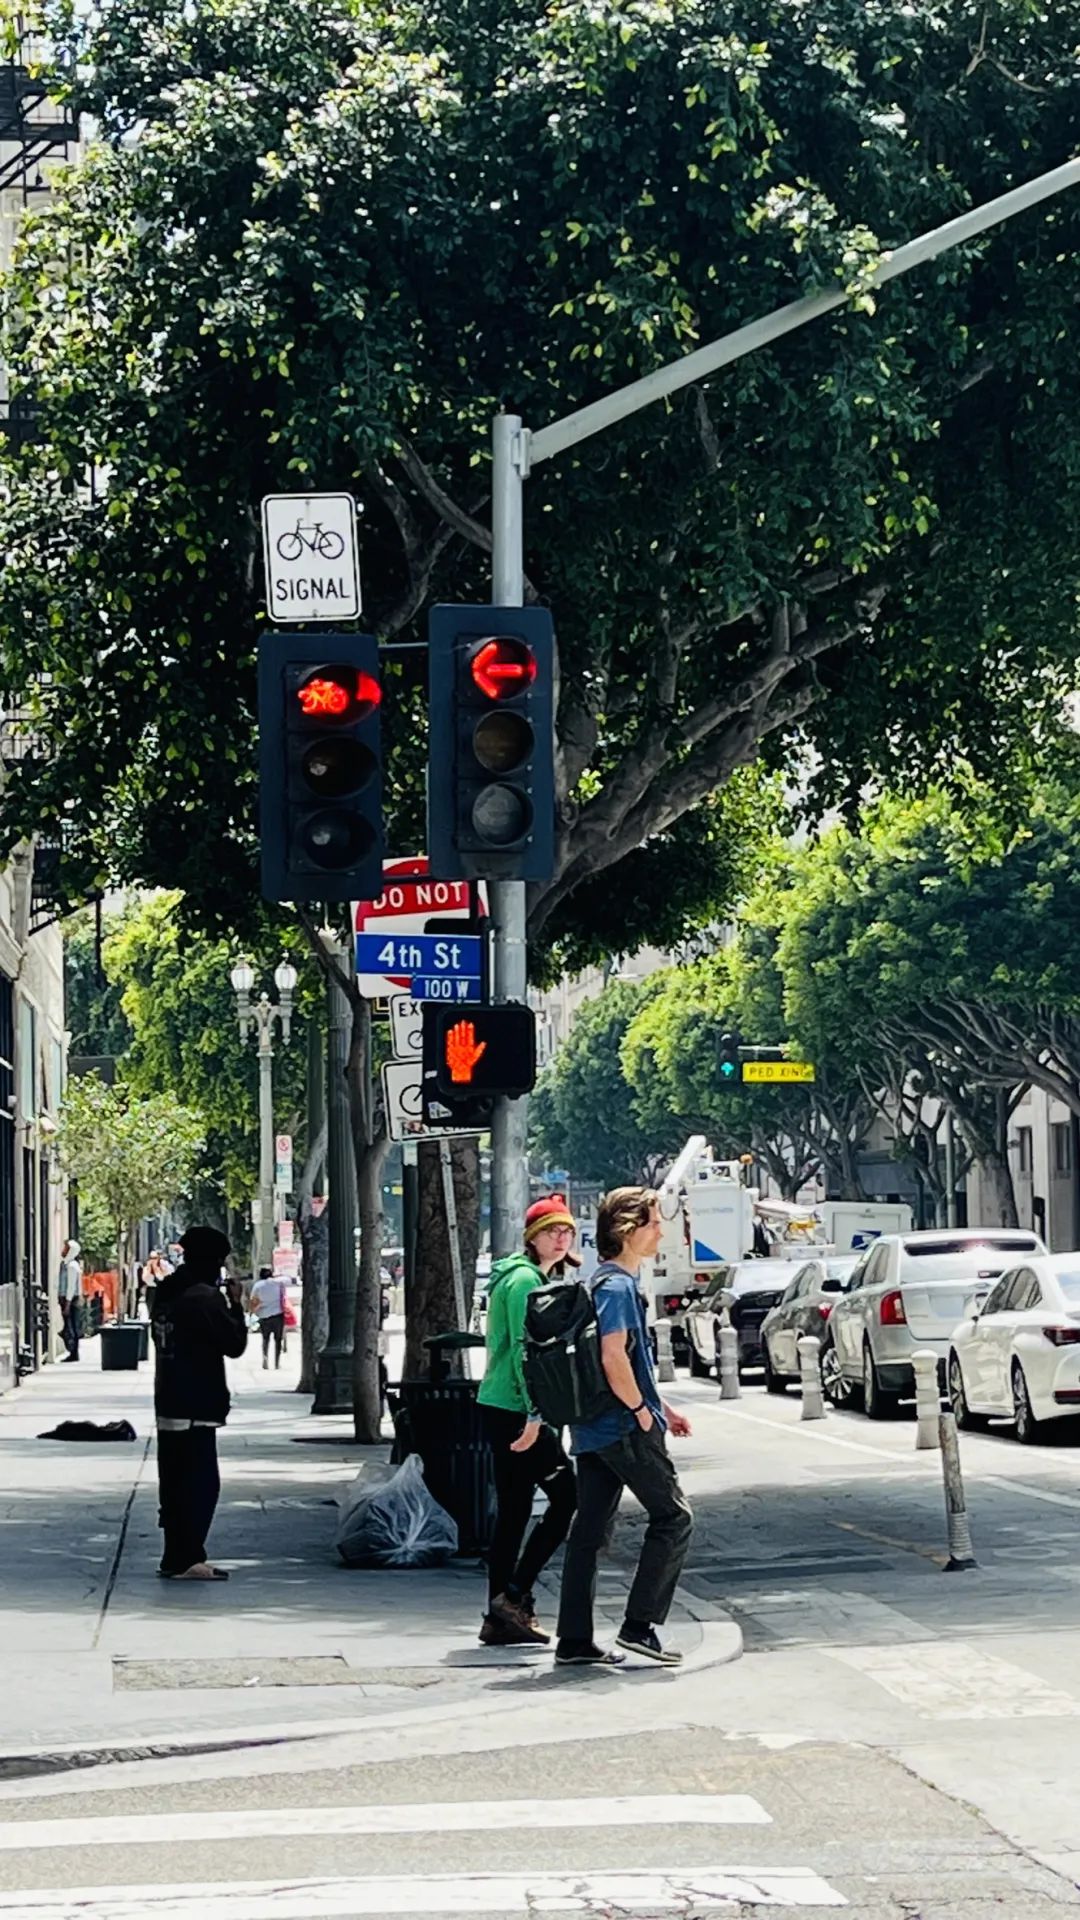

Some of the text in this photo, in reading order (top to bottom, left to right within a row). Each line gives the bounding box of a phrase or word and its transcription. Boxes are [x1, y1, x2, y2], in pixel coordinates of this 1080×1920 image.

[276, 577, 351, 601] SIGNAL
[415, 881, 464, 905] NOT
[377, 941, 462, 970] 4th St
[424, 979, 469, 998] 100 W
[749, 1066, 774, 1078] PED
